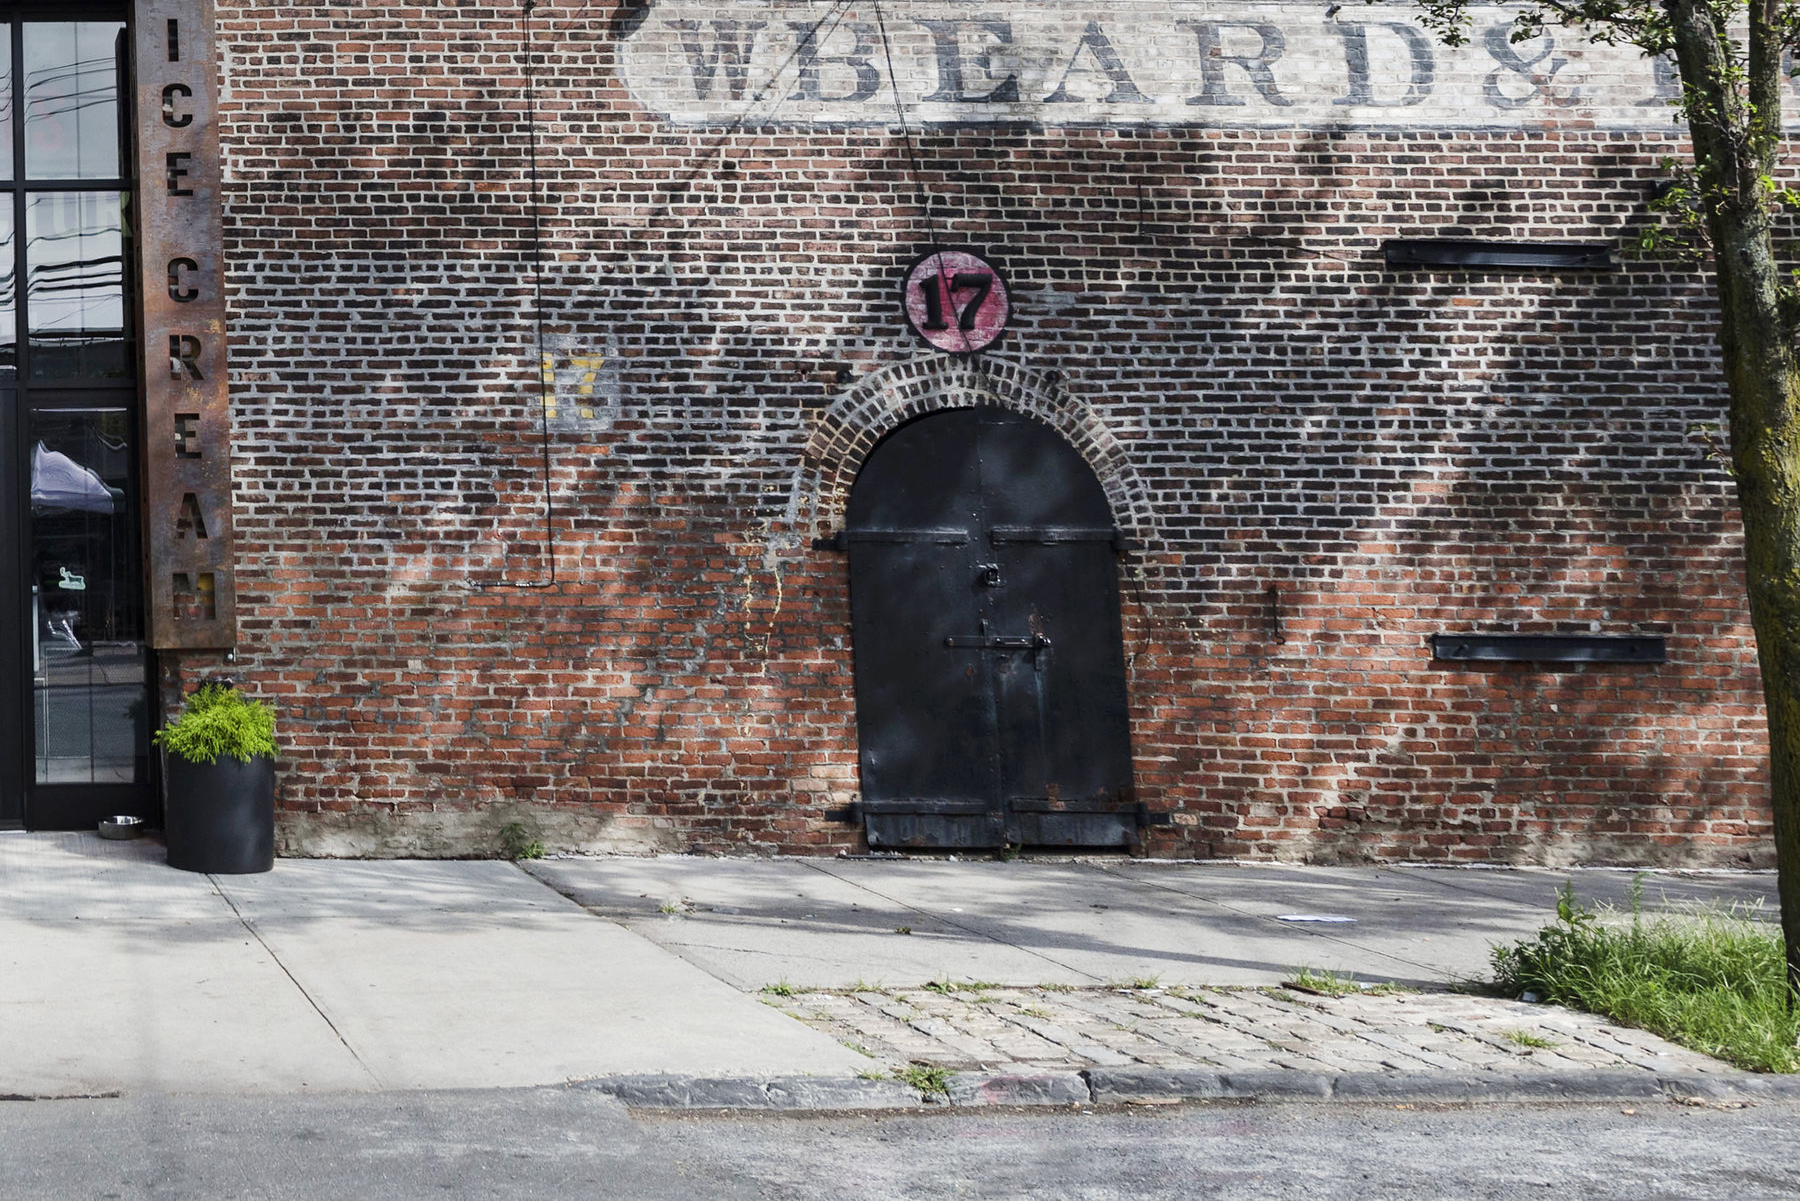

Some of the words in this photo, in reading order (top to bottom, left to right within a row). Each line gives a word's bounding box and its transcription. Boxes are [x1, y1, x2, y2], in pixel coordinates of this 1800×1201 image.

[161, 18, 194, 197] ICE
[785, 18, 1435, 107] BEARD
[1483, 20, 1582, 109] &
[918, 273, 993, 330] 17
[540, 351, 605, 419] 17
[166, 256, 216, 621] CREAM
